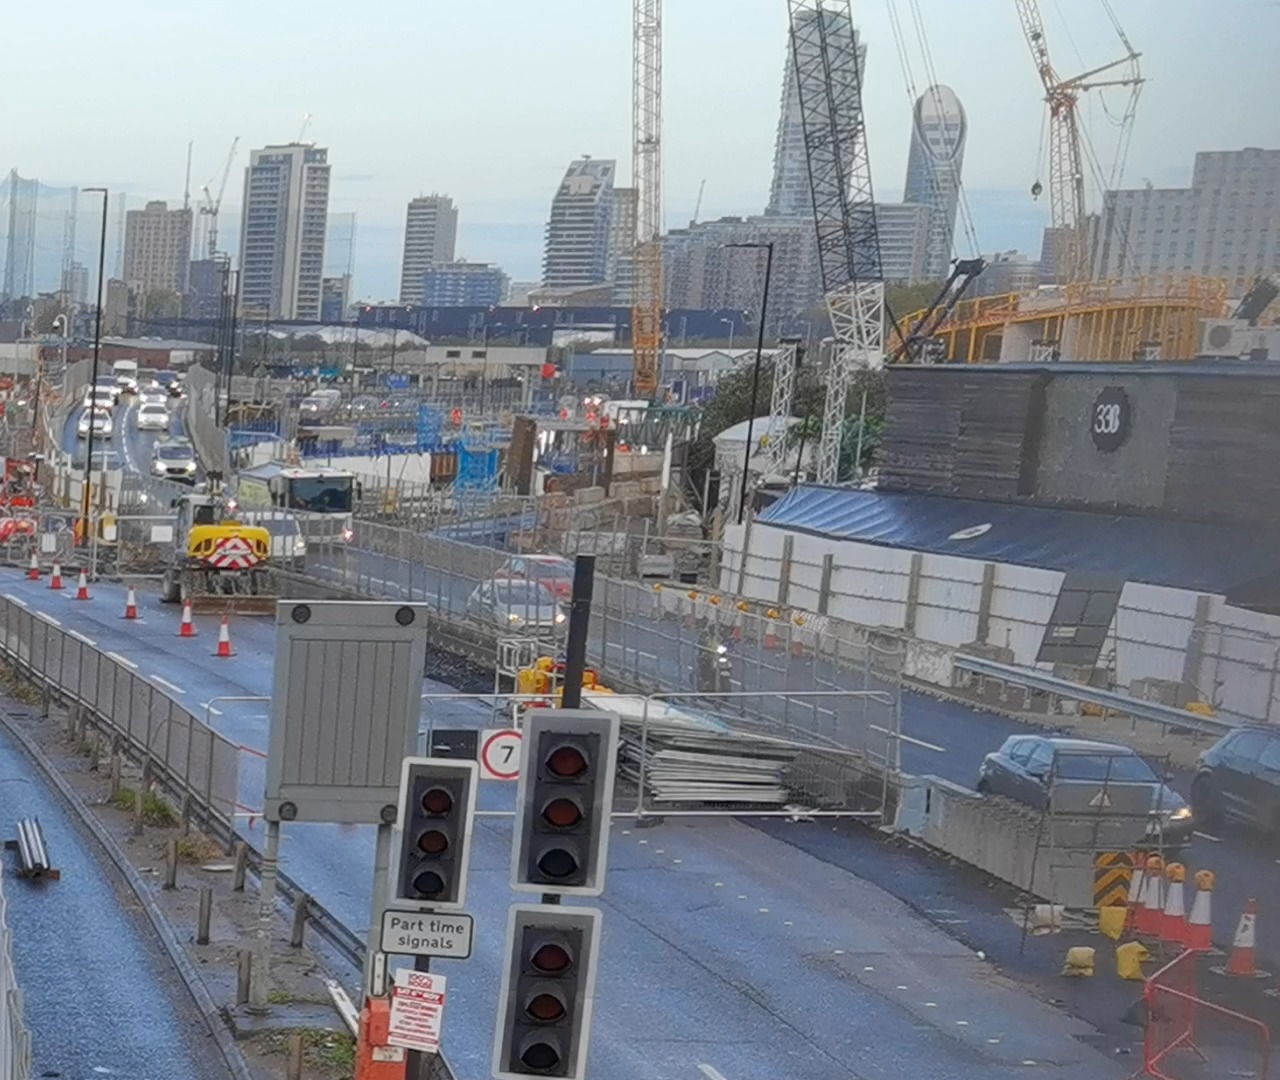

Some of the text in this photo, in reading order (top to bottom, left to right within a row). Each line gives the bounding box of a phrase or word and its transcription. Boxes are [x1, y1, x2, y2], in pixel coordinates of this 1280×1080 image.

[500, 745, 515, 764] 7
[390, 917, 465, 935] Part time
[397, 933, 454, 950] signals
